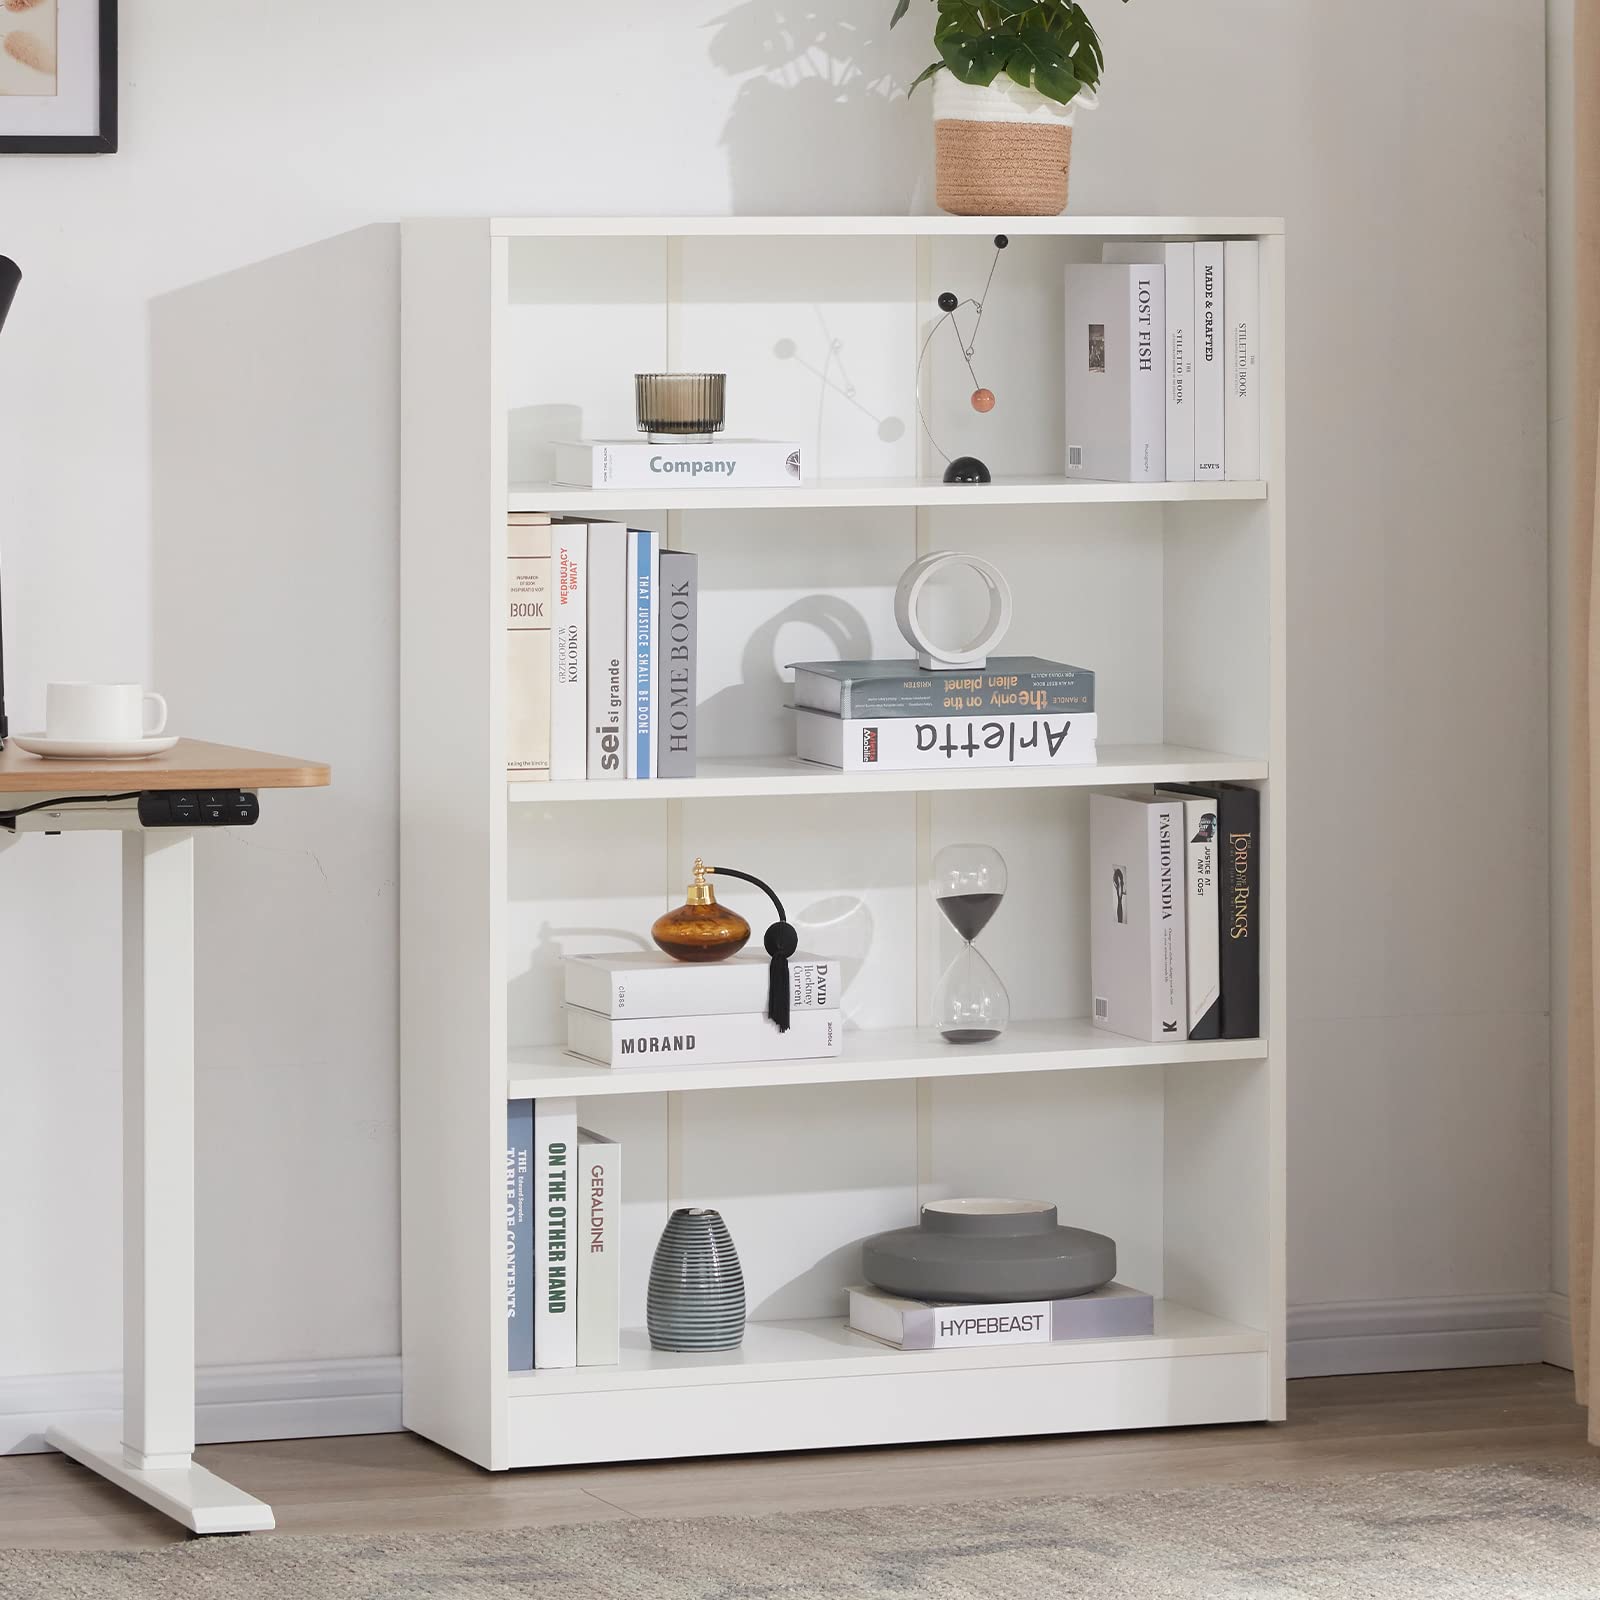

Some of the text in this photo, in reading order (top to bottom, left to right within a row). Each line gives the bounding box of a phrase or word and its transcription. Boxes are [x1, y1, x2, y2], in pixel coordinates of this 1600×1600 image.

[1138, 280, 1152, 371] LOST FISH
[1205, 265, 1213, 362] MADE & CRAFTED
[1239, 323, 1247, 397] STILETTO BOOK
[649, 456, 737, 477] Company
[568, 561, 578, 591] ŚWIAT
[510, 602, 544, 618] BOOK
[568, 625, 578, 683] KOLODKO
[638, 575, 649, 735] THAT JUSTICE SHALL BE DONE
[670, 581, 690, 752] HOME BOOK
[903, 680, 932, 689] KRISTEN
[943, 675, 1018, 692] alien planet
[943, 690, 1049, 711] the only on the
[595, 658, 622, 770] sei si grande
[915, 720, 1071, 762] Arletta
[1159, 813, 1173, 920] FASHIONINDIA
[1229, 832, 1252, 873] LORD
[1204, 878, 1211, 887] AT
[1229, 886, 1250, 939] RINGS
[793, 965, 803, 1007] Current
[803, 965, 814, 1006] Hockney
[816, 964, 828, 1006] DAVID
[621, 1034, 696, 1055] MORAND
[1162, 1021, 1177, 1033] K
[518, 1149, 527, 1173] THE
[548, 1142, 567, 1314] ON THE OTHER HAND
[591, 1165, 604, 1253] GERALDINE
[940, 1314, 1044, 1337] HYPEBEAST
